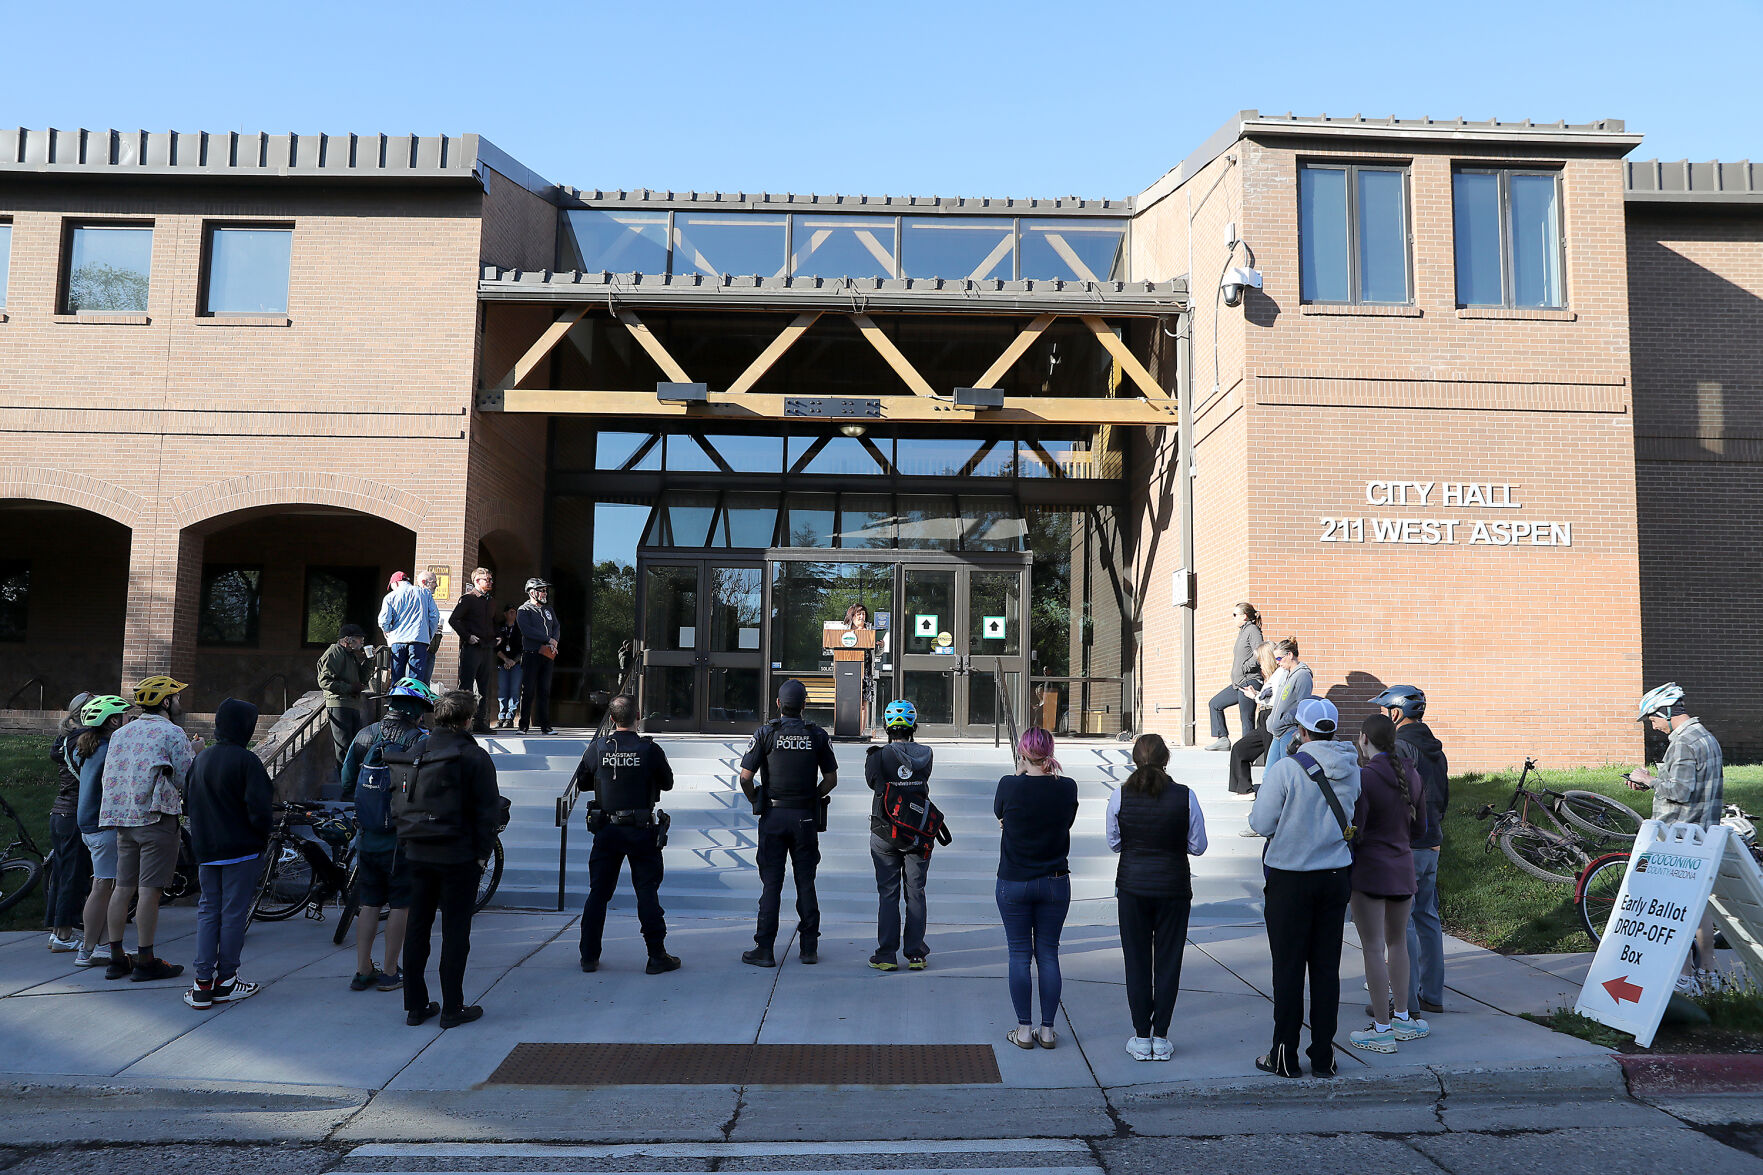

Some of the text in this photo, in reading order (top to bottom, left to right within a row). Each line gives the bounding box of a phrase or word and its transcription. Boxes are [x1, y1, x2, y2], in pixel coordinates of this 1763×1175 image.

[1365, 480, 1522, 508] CITY HALL
[1319, 517, 1572, 547] 211 WEST ASPEN
[776, 740, 812, 750] POLICE
[602, 757, 641, 767] POLICE
[1651, 854, 1701, 870] COCONINO
[1621, 894, 1688, 922] Early Ballot
[1614, 918, 1677, 945] DROP-OFF
[1620, 944, 1643, 966] Box
